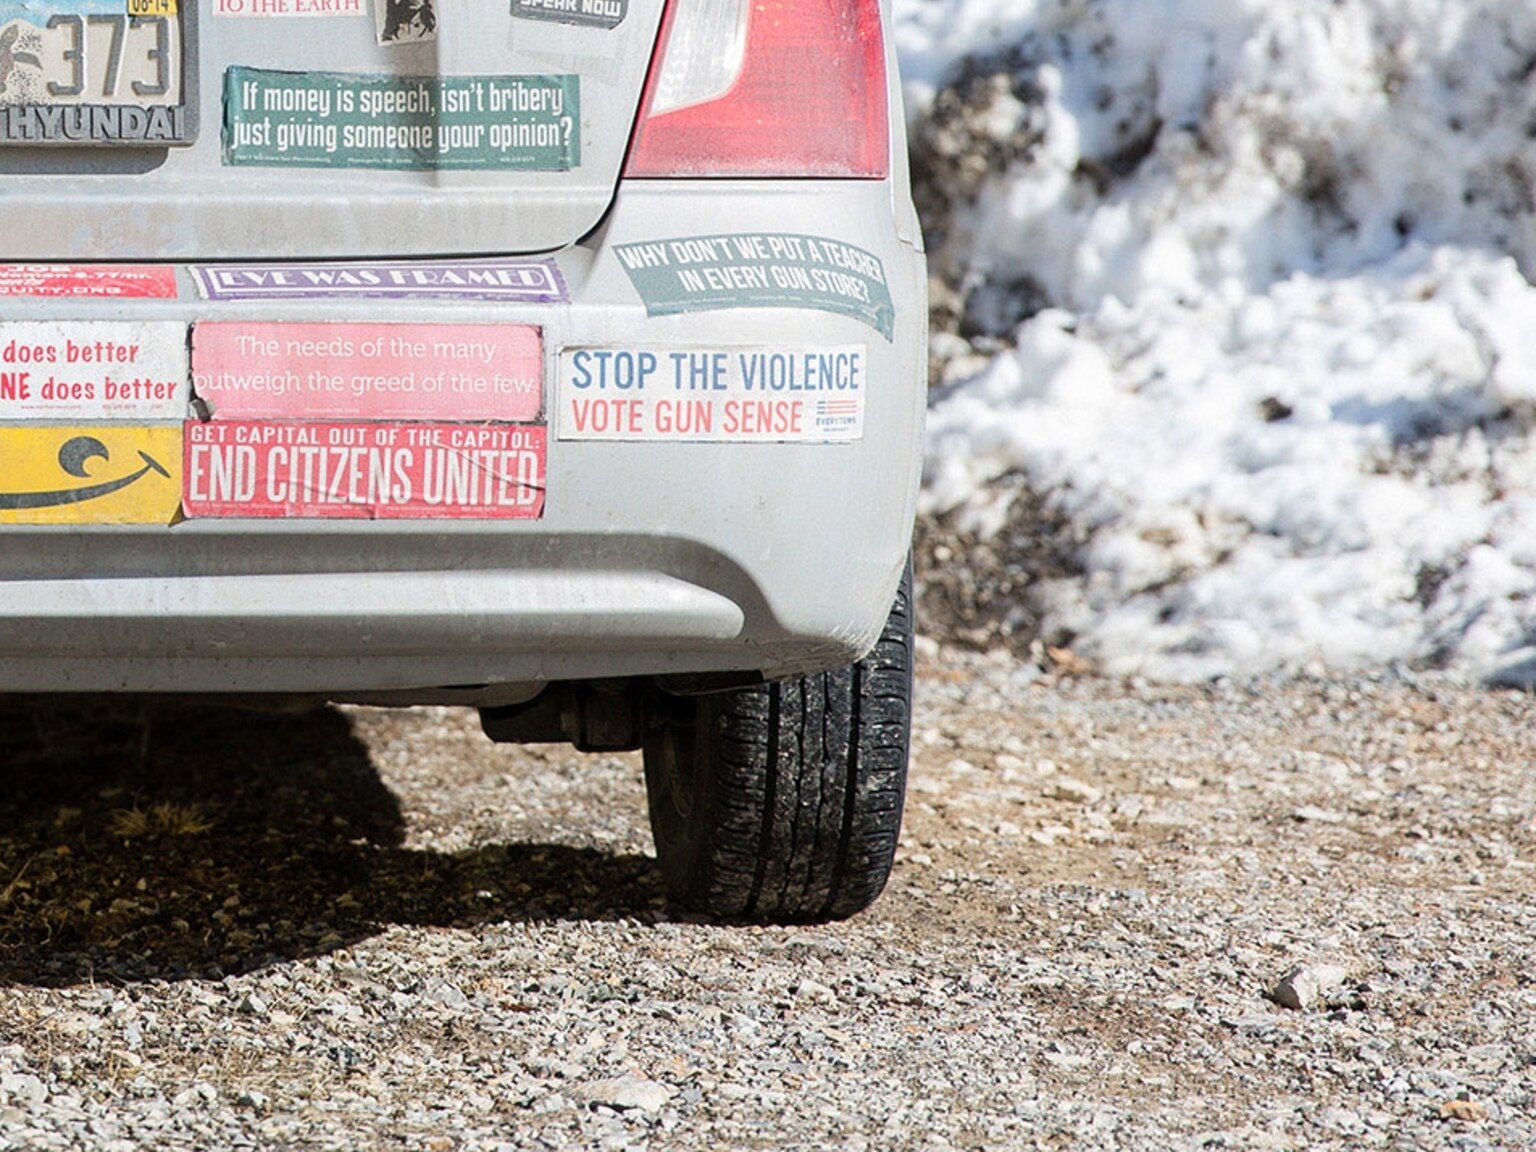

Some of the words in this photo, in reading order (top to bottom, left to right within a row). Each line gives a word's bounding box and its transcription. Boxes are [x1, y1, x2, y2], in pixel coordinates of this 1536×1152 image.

[46, 14, 170, 97] 373
[243, 83, 257, 110] If
[263, 89, 330, 116] money
[336, 85, 354, 112] is
[359, 85, 435, 116] speech,
[441, 85, 484, 112] isn't
[489, 83, 563, 117] bribery
[7, 105, 185, 140] HYUNDAI
[232, 118, 271, 149] just
[277, 119, 336, 151] giving
[343, 124, 432, 148] someone
[438, 125, 484, 153] your
[490, 117, 573, 150] opinion?
[222, 271, 298, 286] EVE
[306, 271, 384, 286] WAS
[389, 268, 544, 287] FRAMED
[619, 245, 669, 270] WHY
[670, 237, 733, 264] DON'T
[733, 237, 765, 260] WE
[771, 239, 806, 261] PUT
[809, 242, 820, 261] A
[823, 242, 885, 285] TEACHER
[676, 270, 706, 292] IN
[708, 267, 768, 291] EVERY
[772, 267, 814, 289] GUN
[814, 270, 868, 303] STORE?
[3, 341, 56, 363] does
[66, 340, 139, 363] better
[235, 335, 279, 357] The
[286, 338, 352, 357] needs
[361, 337, 384, 357] of
[390, 337, 425, 357] the
[433, 341, 497, 363] many
[195, 371, 302, 396] outweigh
[308, 372, 344, 392] the
[351, 372, 415, 397] greed
[422, 372, 447, 392] of
[453, 372, 488, 392] the
[493, 373, 538, 393] few.
[572, 351, 657, 389] STOP
[669, 353, 727, 390] THE
[739, 353, 859, 390] VIOLENCE
[41, 377, 94, 400] does
[104, 377, 177, 400] better
[572, 399, 643, 432] VOTE
[655, 399, 713, 433] GUN
[723, 401, 803, 433] SENSE
[191, 425, 226, 442] GET
[236, 426, 319, 444] CAPITAL
[330, 429, 366, 445] OUT
[375, 430, 398, 446] OF
[408, 430, 443, 446] THE
[452, 430, 540, 449] CAPITOL:
[189, 445, 259, 502] END
[267, 447, 413, 504] CITIZENS
[423, 448, 538, 506] UNITED
